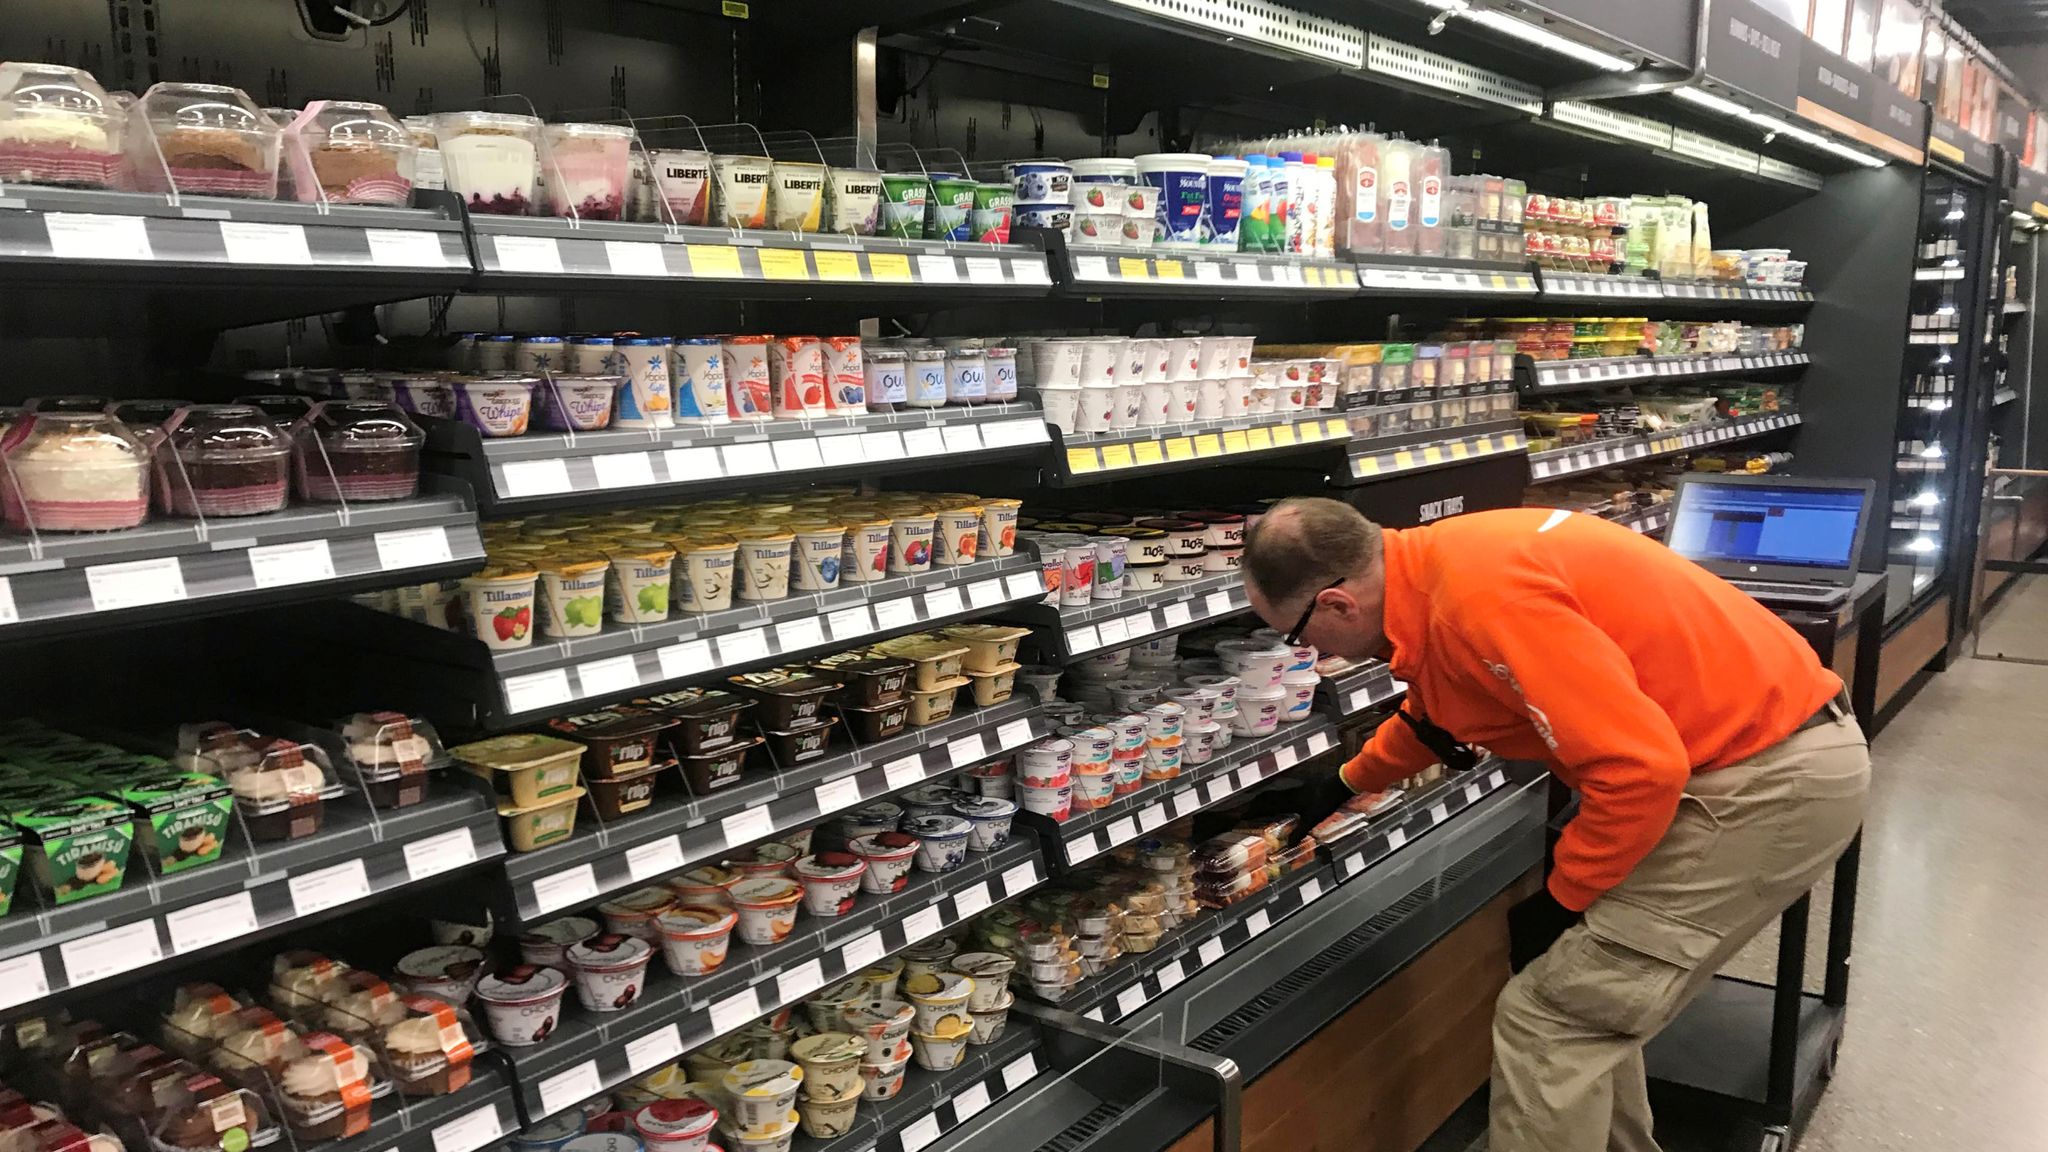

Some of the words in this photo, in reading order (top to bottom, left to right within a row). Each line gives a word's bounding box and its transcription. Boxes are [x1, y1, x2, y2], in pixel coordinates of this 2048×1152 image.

[798, 702, 815, 716] flip
[708, 721, 729, 737] flip
[802, 735, 820, 750] flip
[620, 744, 644, 760] flip
[717, 760, 737, 776] flip
[628, 784, 649, 800] flip
